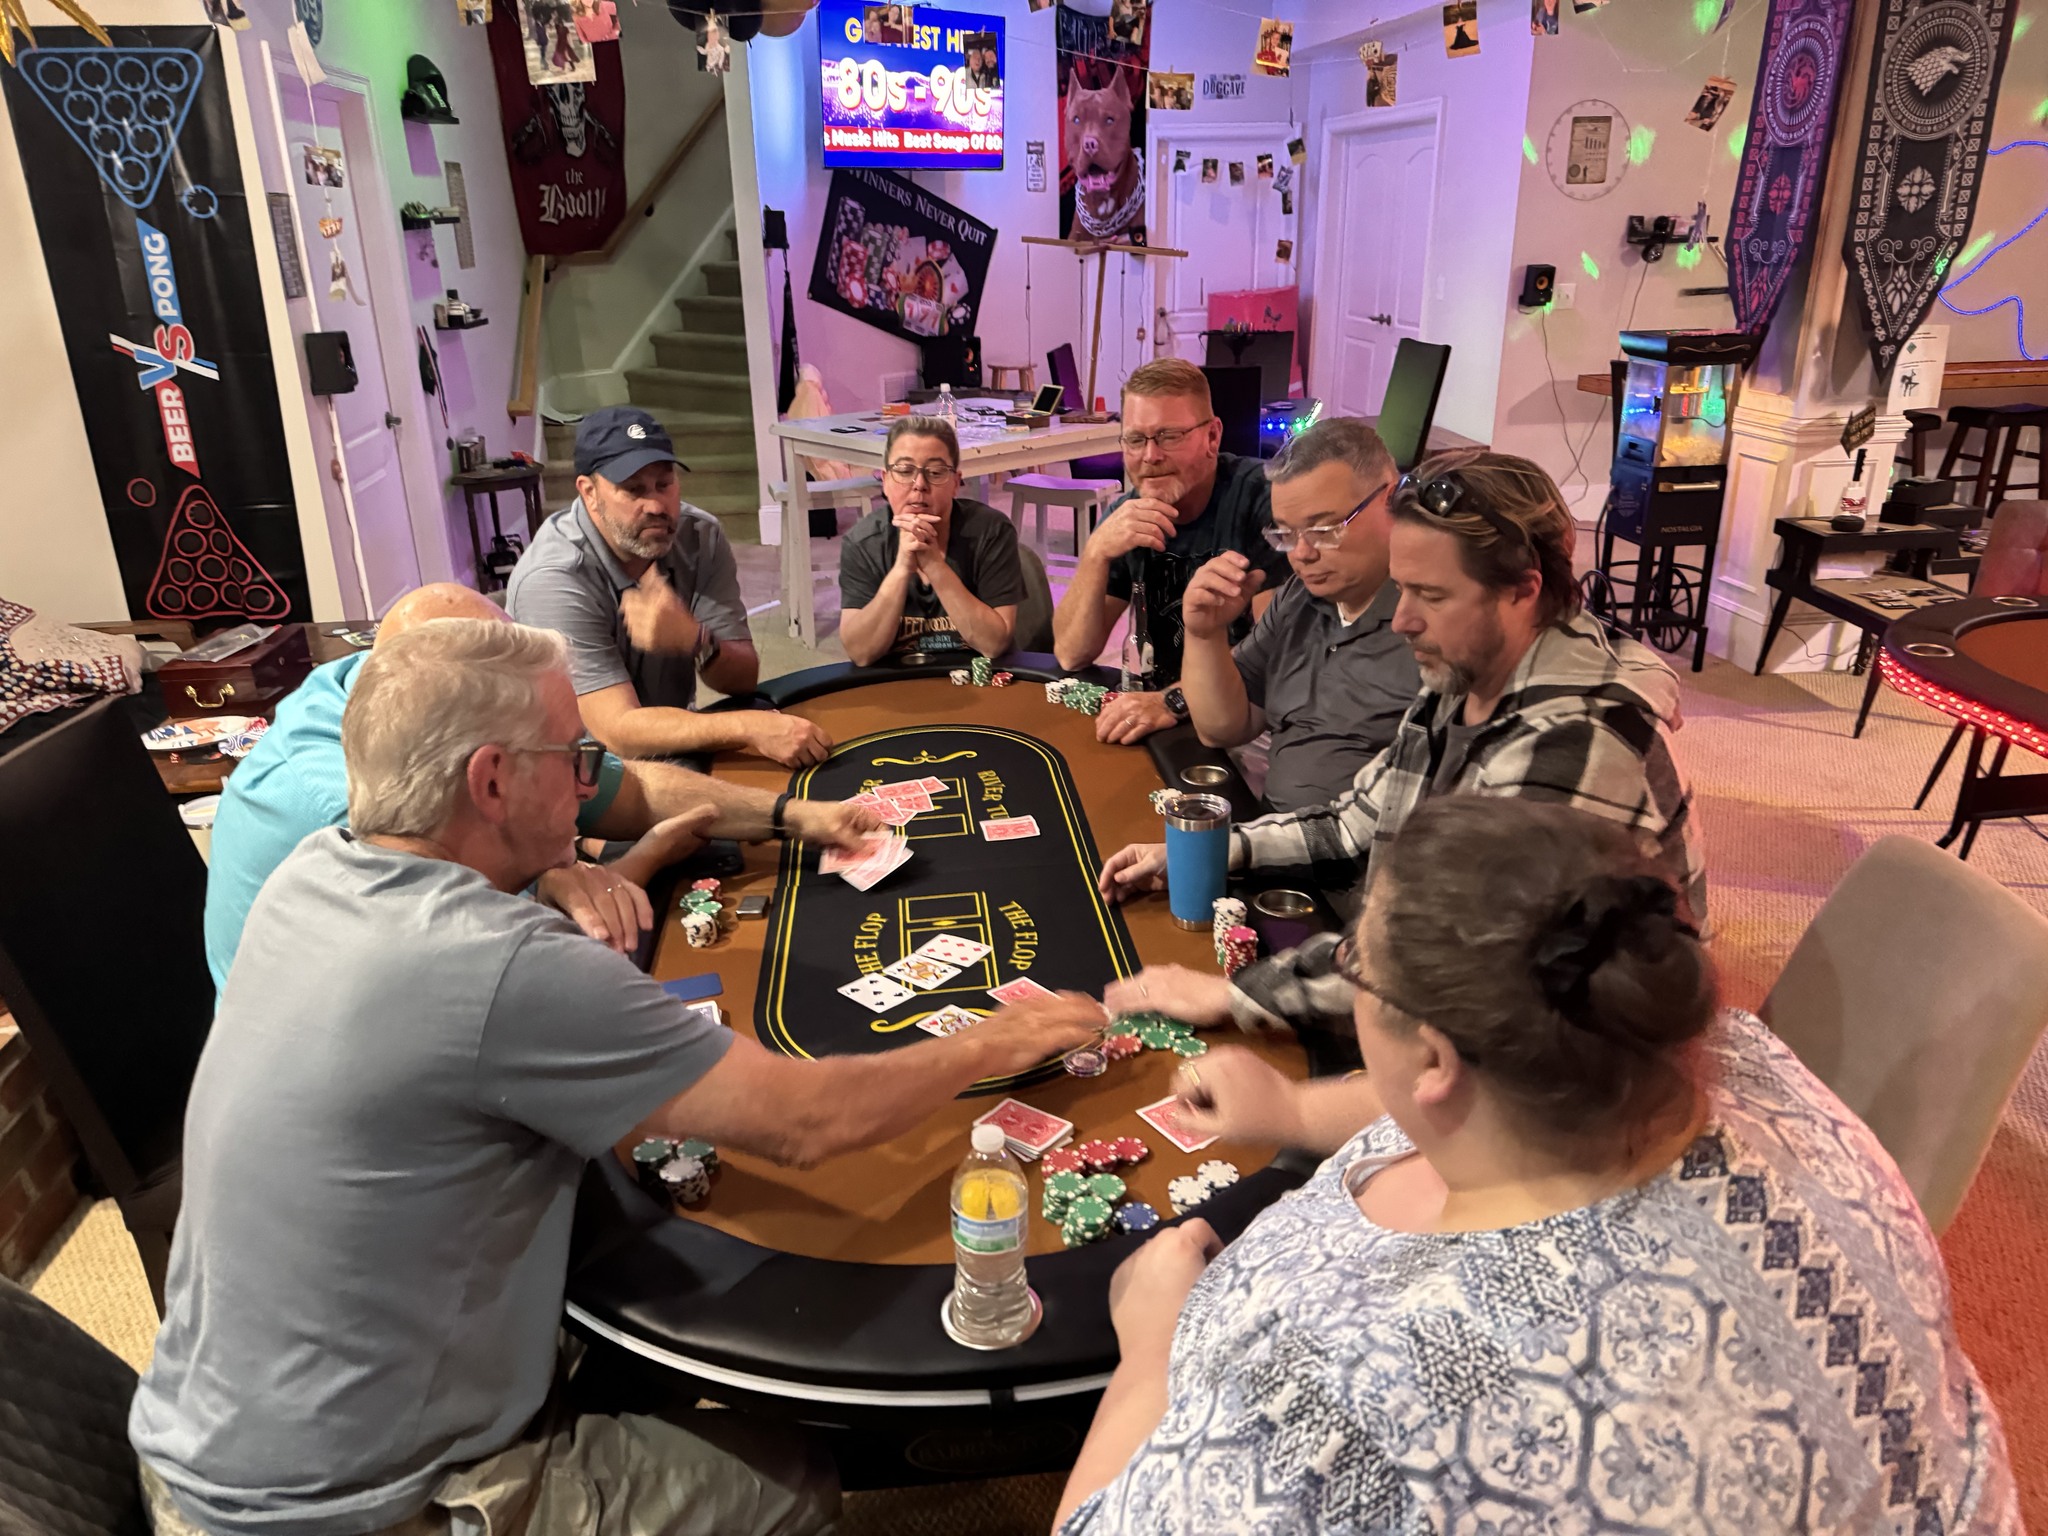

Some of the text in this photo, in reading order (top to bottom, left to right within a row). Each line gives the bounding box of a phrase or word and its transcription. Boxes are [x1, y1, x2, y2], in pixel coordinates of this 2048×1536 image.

[838, 57, 908, 112] 80s
[831, 129, 871, 147] Music
[873, 130, 900, 148] Hits
[903, 132, 932, 149] Best
[933, 132, 970, 153] Songs
[970, 134, 985, 150] Of
[565, 168, 584, 185] the
[850, 168, 988, 246] WINNERS NEVER QUIT
[133, 231, 196, 463] BEER VS PONG
[1661, 524, 1704, 533] NOSTALGIA
[977, 769, 1010, 819] RIVER TU
[853, 912, 889, 977] HE FLOP
[998, 900, 1038, 970] THE FLOP
